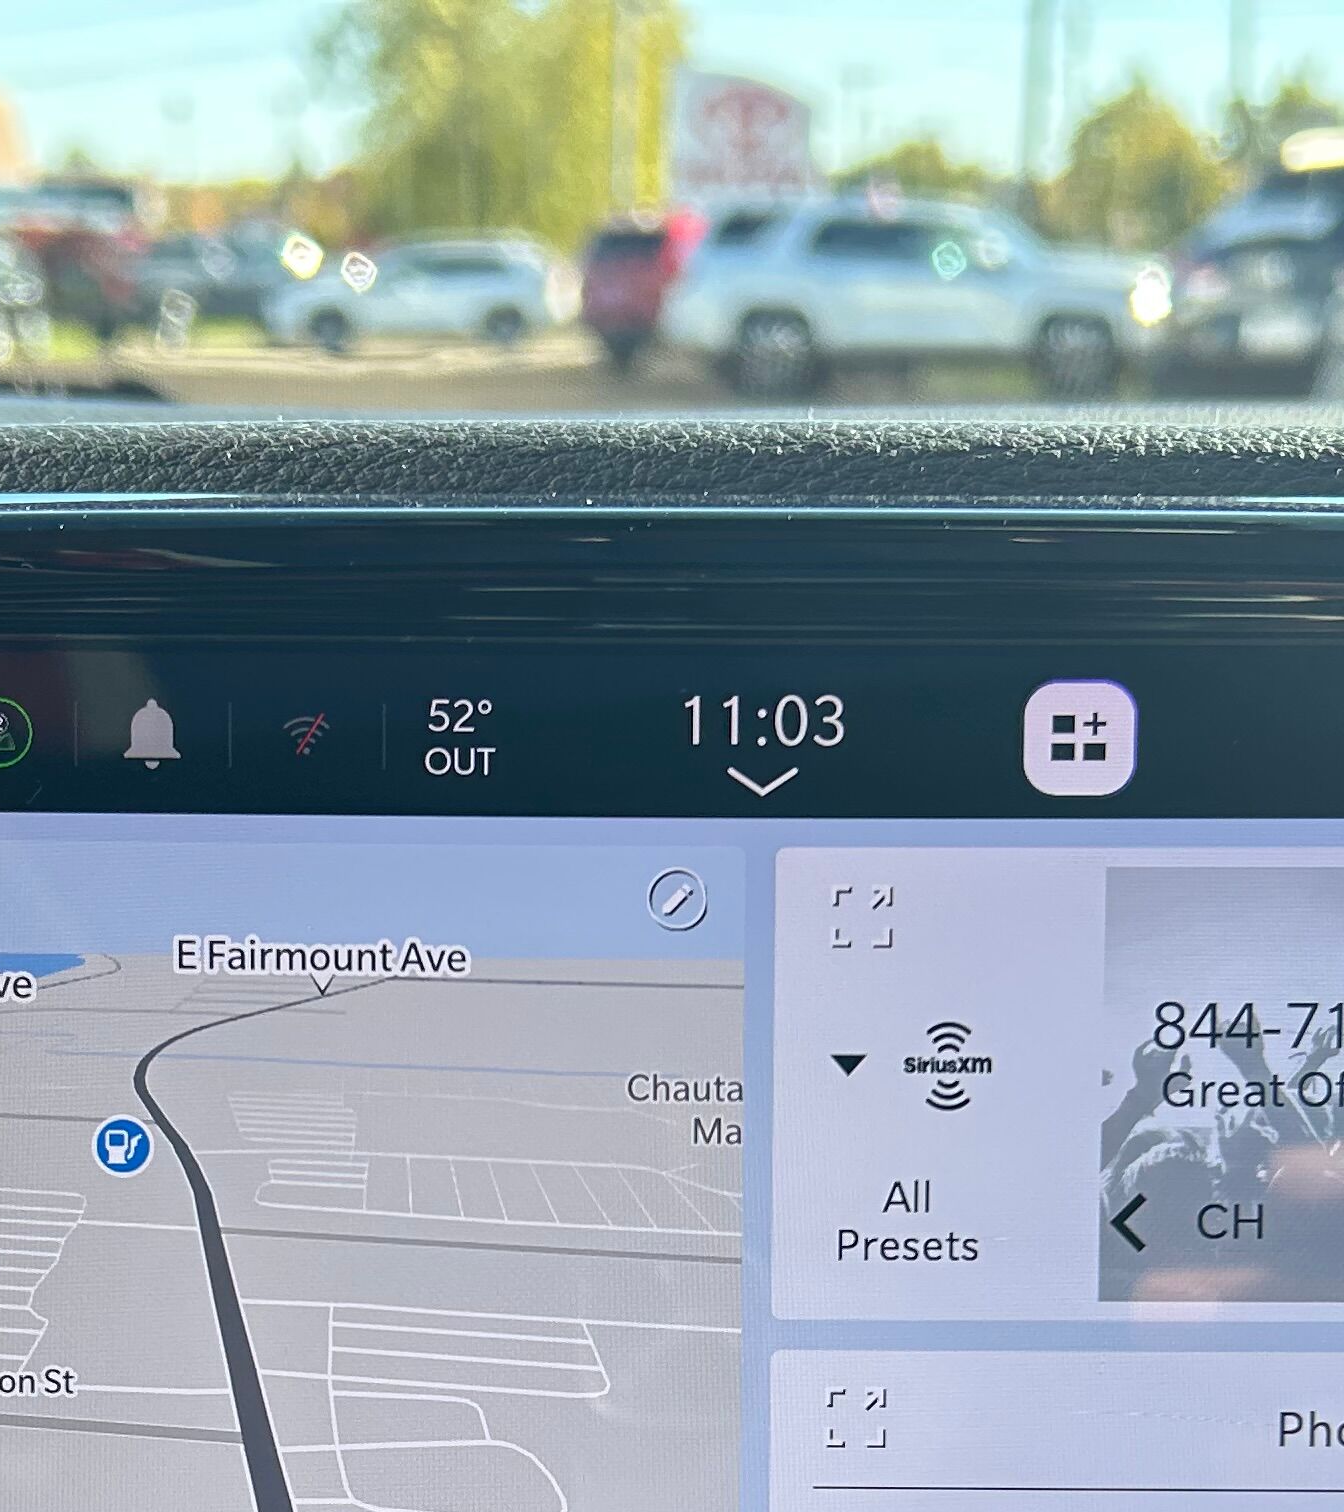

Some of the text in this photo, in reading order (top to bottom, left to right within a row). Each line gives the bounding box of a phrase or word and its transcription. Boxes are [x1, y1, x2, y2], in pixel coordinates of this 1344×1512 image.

[428, 698, 492, 733] 52°
[684, 694, 844, 747] 11:03
[424, 747, 496, 776] OUT
[178, 939, 467, 973] E Fairmount Ave
[627, 1073, 743, 1102] Chauta
[1162, 1071, 1286, 1108] Great
[693, 1117, 742, 1145] Ma
[882, 1179, 930, 1213] All
[1197, 1203, 1264, 1240] CH
[838, 1229, 979, 1262] Presets
[44, 1368, 75, 1395] St
